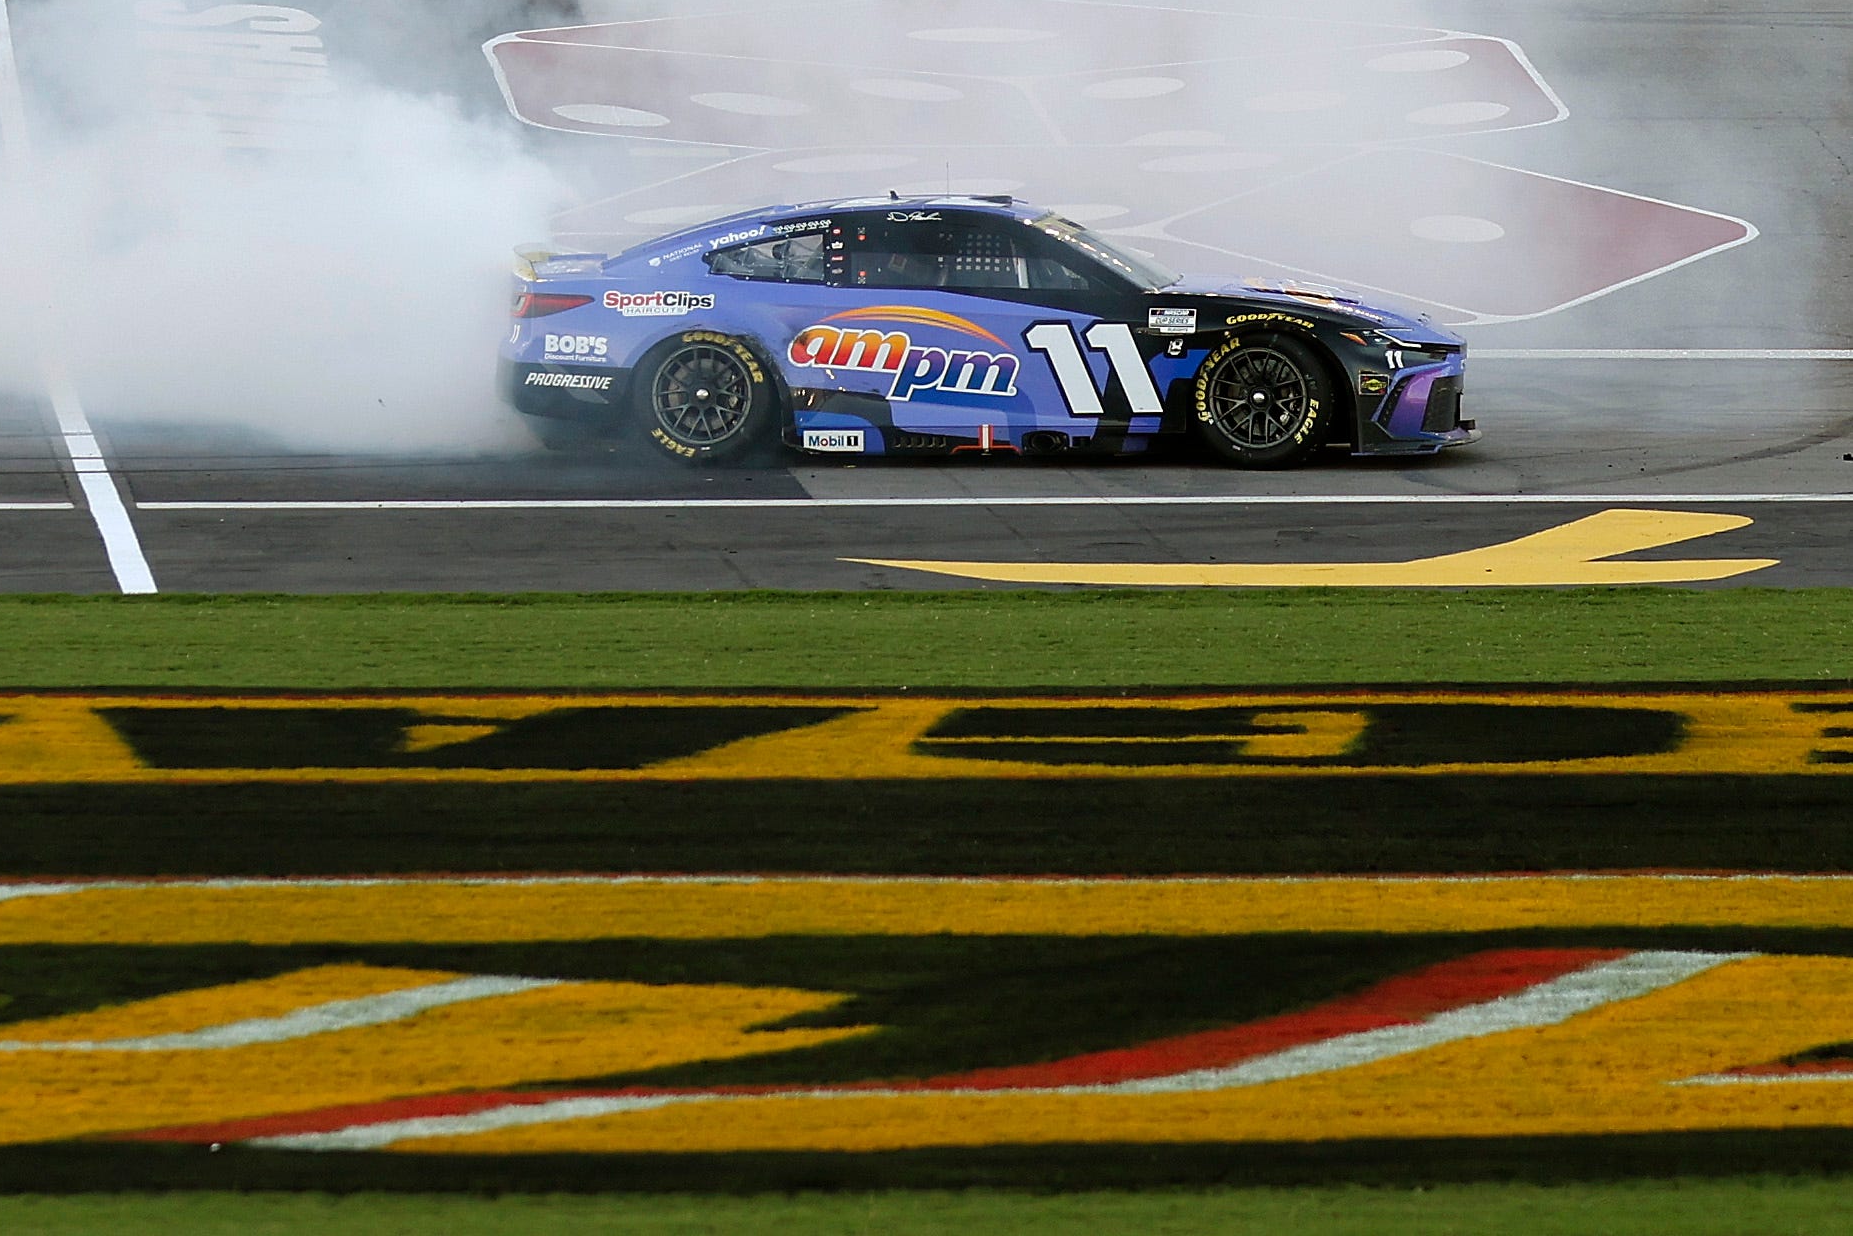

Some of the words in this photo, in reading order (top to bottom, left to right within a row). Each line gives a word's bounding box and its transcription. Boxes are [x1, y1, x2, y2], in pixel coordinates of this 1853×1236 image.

[708, 224, 766, 250] yahoo!
[1226, 312, 1315, 329] GOODYEAR
[545, 334, 608, 354] BOB'S
[788, 325, 1020, 402] ampm
[1023, 321, 1165, 415] 11
[1385, 350, 1404, 369] 11
[525, 372, 614, 390] PROGRESSIVE
[1294, 398, 1319, 445] EAGLE
[808, 435, 845, 447] Mobil
[848, 436, 859, 447] 1
